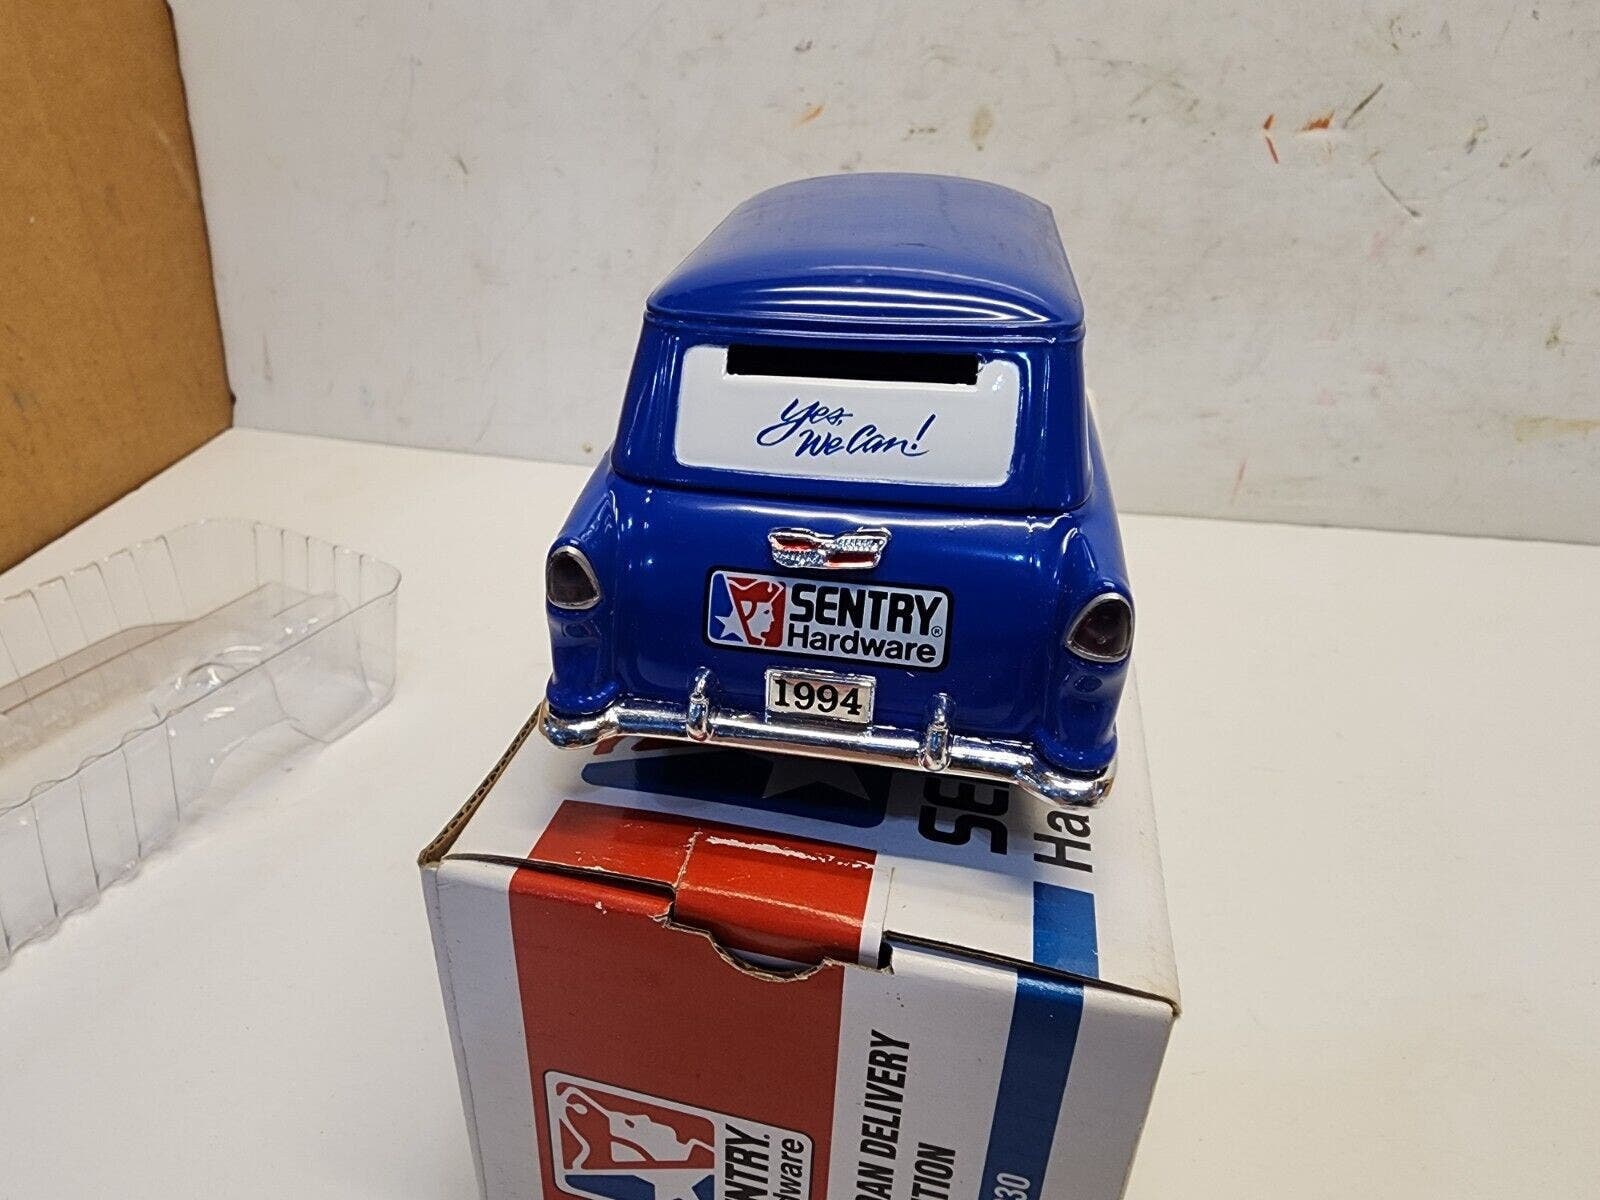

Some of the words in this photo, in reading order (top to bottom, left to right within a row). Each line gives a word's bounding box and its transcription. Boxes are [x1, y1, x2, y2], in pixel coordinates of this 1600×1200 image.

[787, 623, 937, 663] Hardware
[774, 679, 863, 716] 1994
[918, 776, 1010, 855] SE
[1033, 810, 1093, 873] Ha
[860, 1028, 910, 1160] DELIVERY
[911, 1141, 956, 1200] TION
[993, 1172, 1031, 1200] 30
